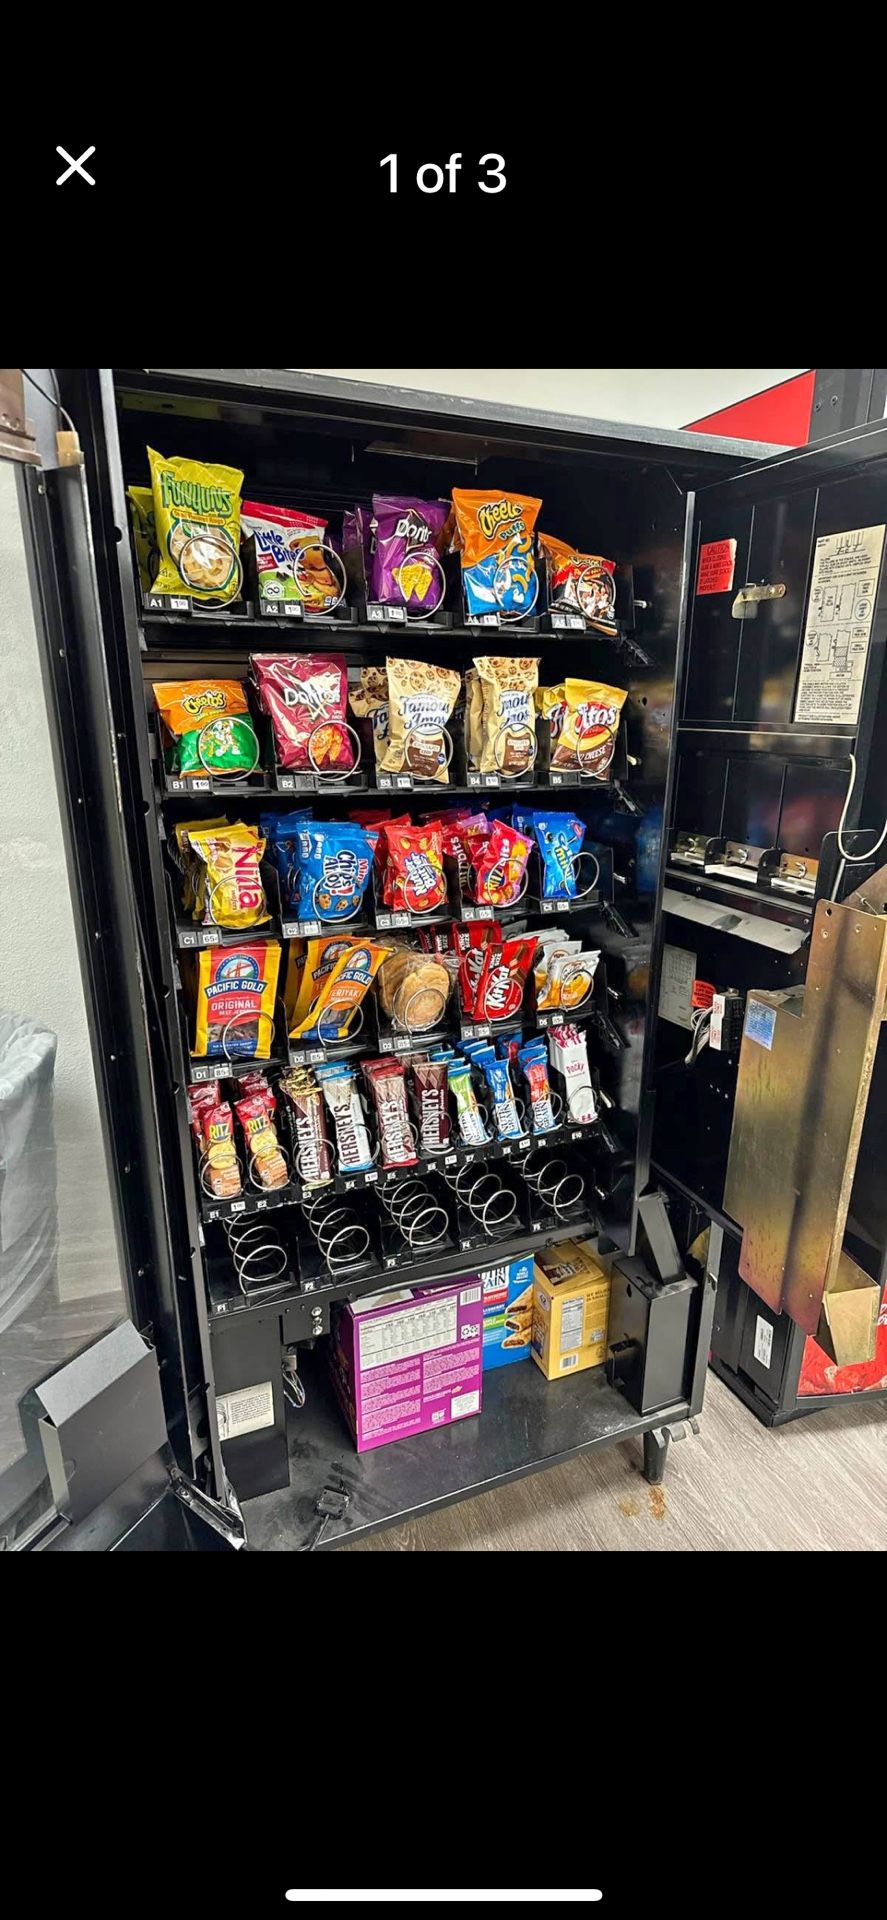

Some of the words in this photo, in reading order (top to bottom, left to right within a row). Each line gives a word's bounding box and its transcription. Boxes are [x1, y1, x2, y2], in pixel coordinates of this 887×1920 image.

[479, 500, 522, 538] Cheeto
[395, 519, 432, 543] Dorit
[253, 530, 285, 552] Little
[150, 599, 162, 607] A1
[371, 609, 382, 618] A3
[183, 691, 225, 714] Cheetos
[173, 781, 184, 789] B1
[282, 780, 293, 788] B2
[232, 847, 261, 909] Nilla
[287, 927, 297, 935] C2
[184, 936, 194, 944] C1
[354, 970, 373, 985] GOLD
[206, 981, 239, 997] PACIFIC
[241, 981, 264, 992] GOLD
[211, 1000, 257, 1011] ORIGINAL
[294, 1055, 304, 1063] D2
[196, 1071, 206, 1079] D1
[208, 1123, 230, 1139] RITZ
[247, 1116, 269, 1134] RITZ
[334, 1103, 360, 1165] HERSHEY'S
[210, 1211, 219, 1219] E1
